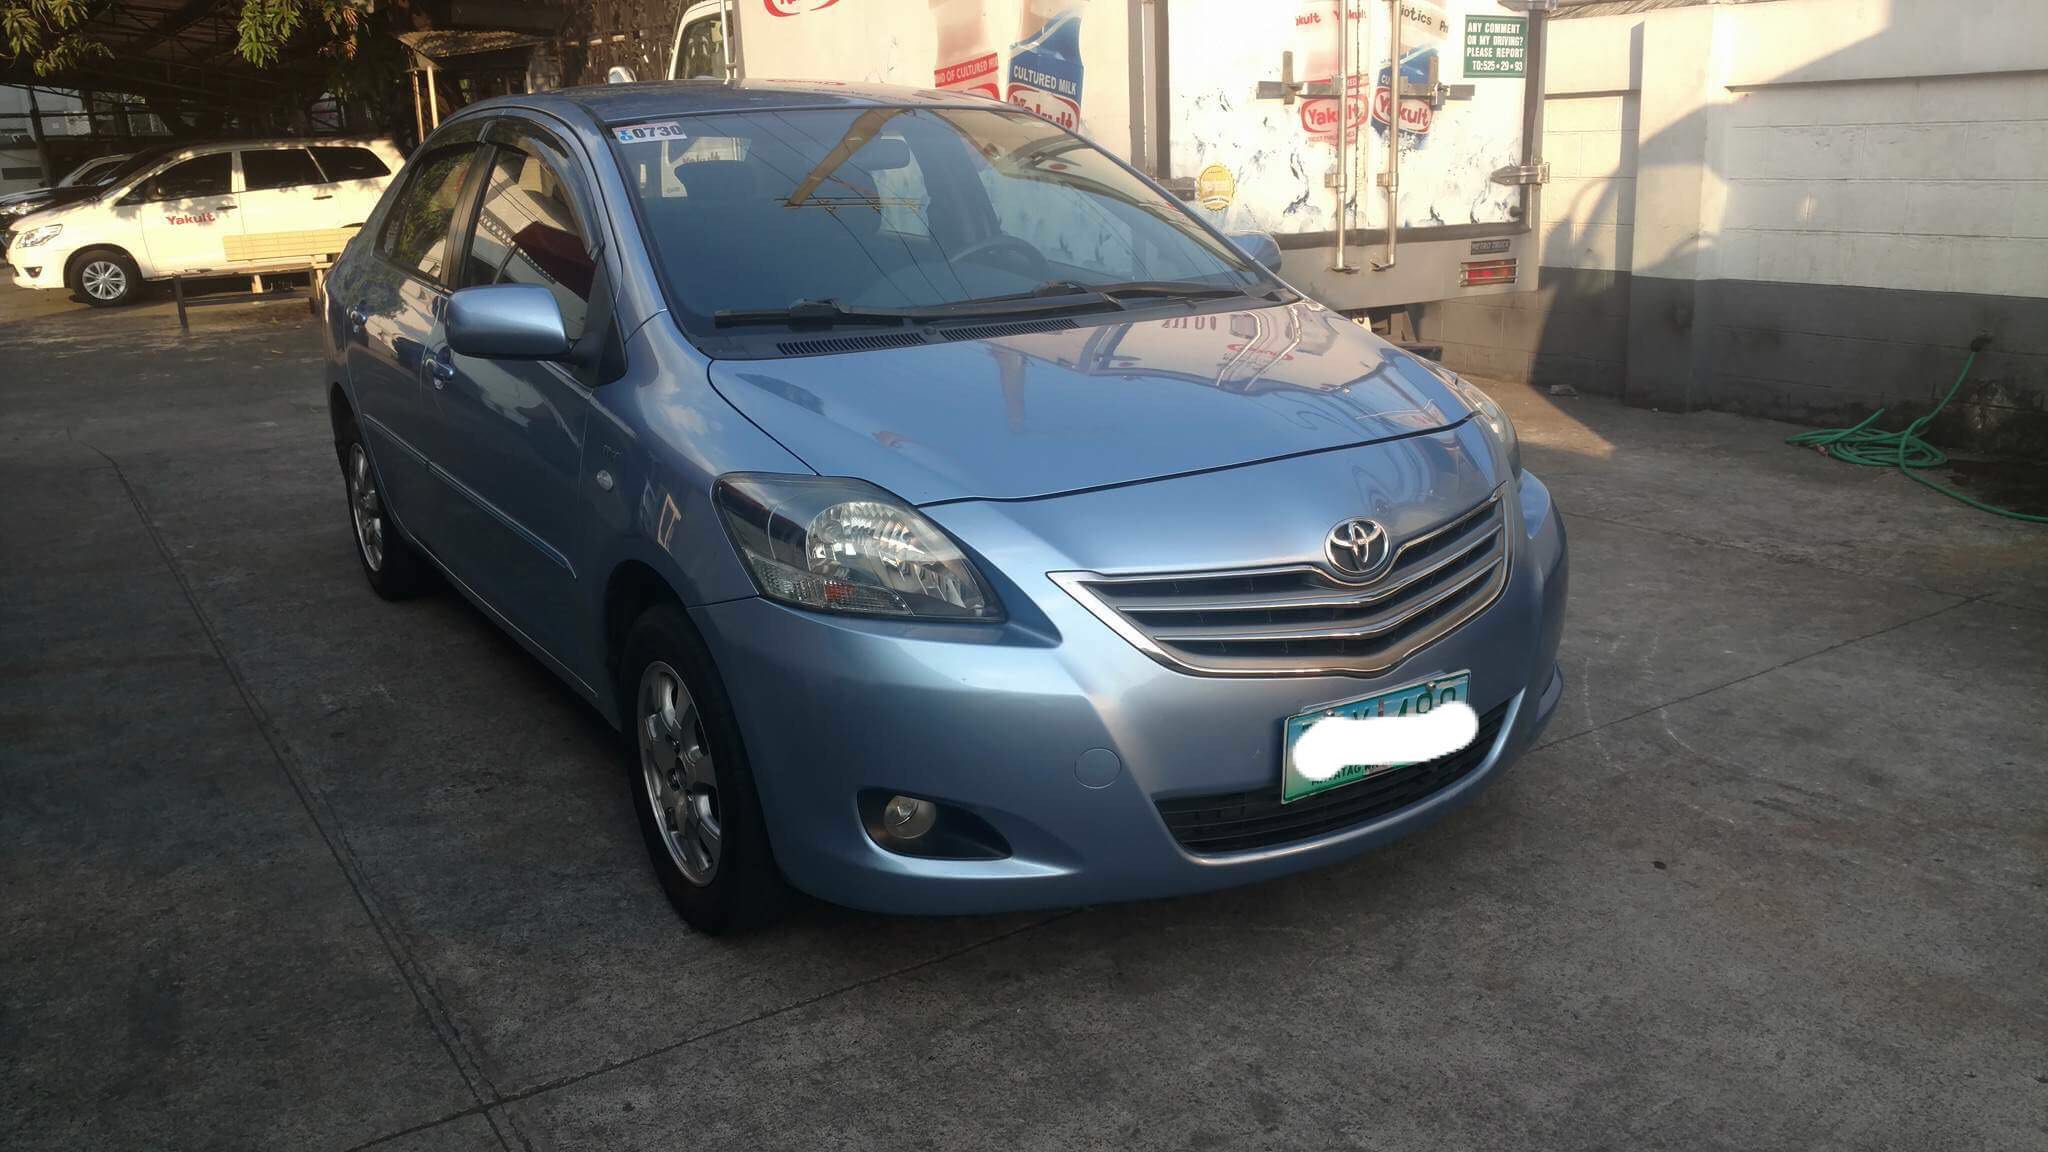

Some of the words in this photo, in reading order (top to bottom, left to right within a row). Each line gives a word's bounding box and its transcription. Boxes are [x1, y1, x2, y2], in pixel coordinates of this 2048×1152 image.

[1400, 5, 1432, 25] iotics
[1467, 22, 1482, 32] ANY
[1484, 23, 1520, 33] COMMENT
[1467, 35, 1477, 45] ON
[1479, 36, 1490, 45] MY
[1493, 36, 1524, 46] DRIVING?
[1466, 47, 1493, 57] PLEASE
[1496, 48, 1524, 57] REPORT
[946, 70, 956, 82] OF
[956, 60, 988, 79] CULTURED
[1014, 65, 1056, 88] CULTURED
[1058, 79, 1077, 95] MILK
[1380, 94, 1429, 126] Ykult
[632, 125, 683, 138] 0730
[165, 211, 216, 225] Yakult
